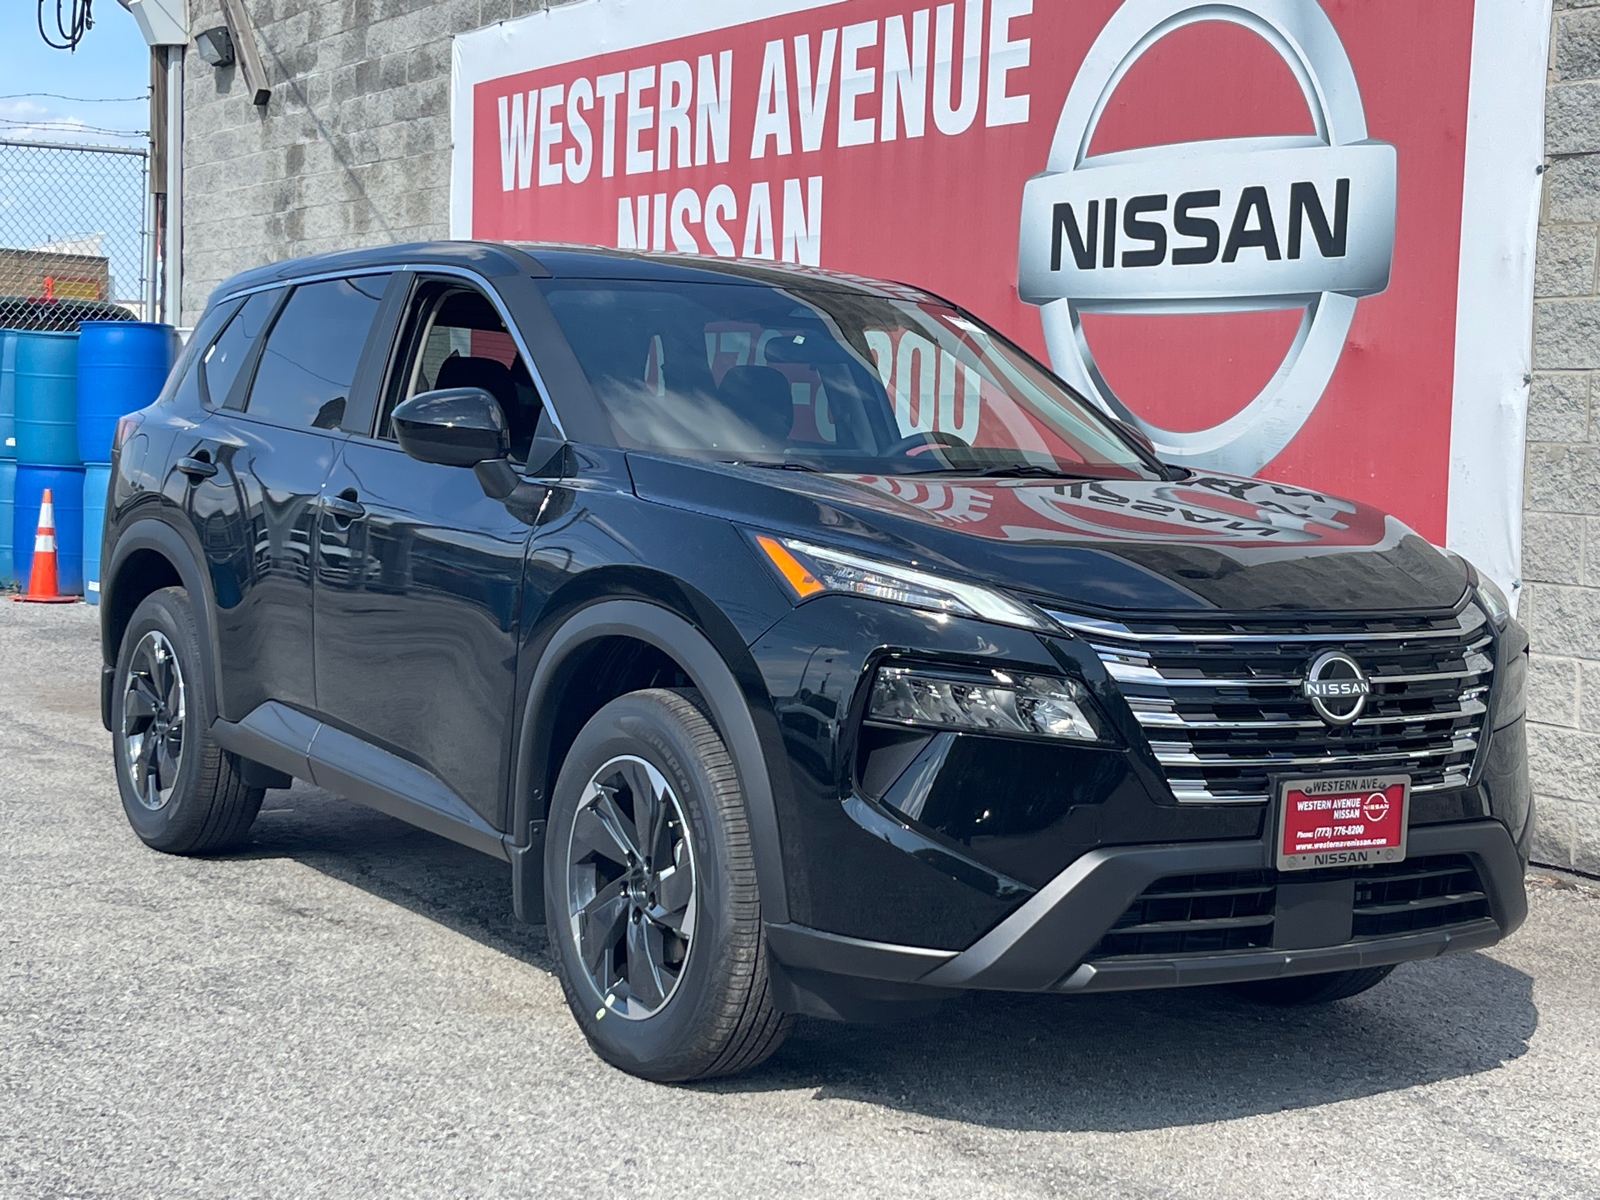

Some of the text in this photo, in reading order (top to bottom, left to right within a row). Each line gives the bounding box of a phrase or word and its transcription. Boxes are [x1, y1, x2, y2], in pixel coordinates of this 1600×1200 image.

[497, 0, 1033, 192] WESTERN AVENUE
[616, 176, 824, 267] NISSAN
[1050, 178, 1350, 271] NISSAN
[1306, 682, 1370, 695] NISSAN
[1313, 779, 1358, 792] WESTERN
[1297, 798, 1361, 811] WESTERN AVENUE
[1333, 809, 1360, 819] NISSAN
[1314, 827, 1332, 839] (773)
[1333, 825, 1364, 837] 776-8200
[1295, 838, 1387, 851] www.westernavenissan.com
[1314, 851, 1368, 865] NISSAN
